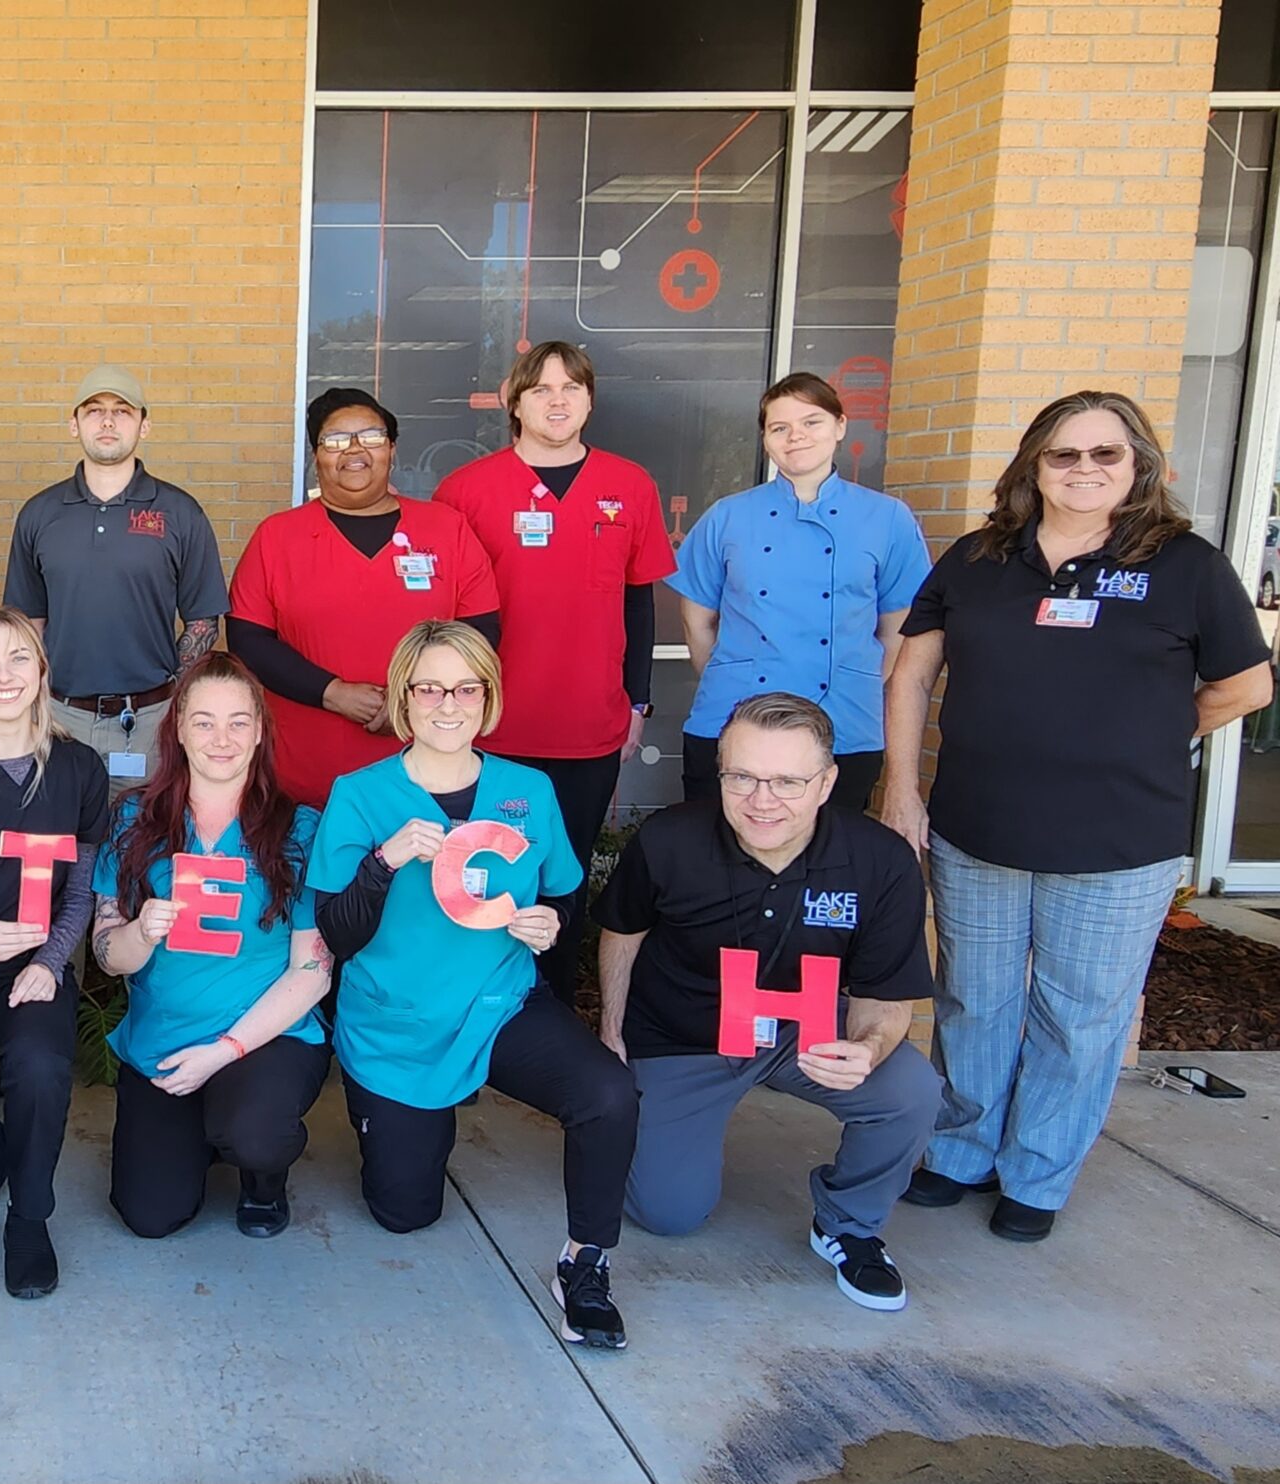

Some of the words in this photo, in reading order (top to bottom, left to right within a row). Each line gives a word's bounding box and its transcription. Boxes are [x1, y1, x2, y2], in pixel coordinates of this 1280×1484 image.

[596, 500, 624, 510] TECH
[130, 508, 164, 521] LAKE
[131, 519, 165, 533] TECH
[1096, 568, 1150, 584] LAKE
[1099, 580, 1149, 597] TECH
[495, 798, 529, 812] LAKE
[500, 808, 530, 819] TECH
[804, 887, 858, 908] LAKE
[807, 904, 858, 923] TECH
[166, 852, 247, 958] E
[431, 819, 530, 930] C
[718, 946, 841, 1059] H
